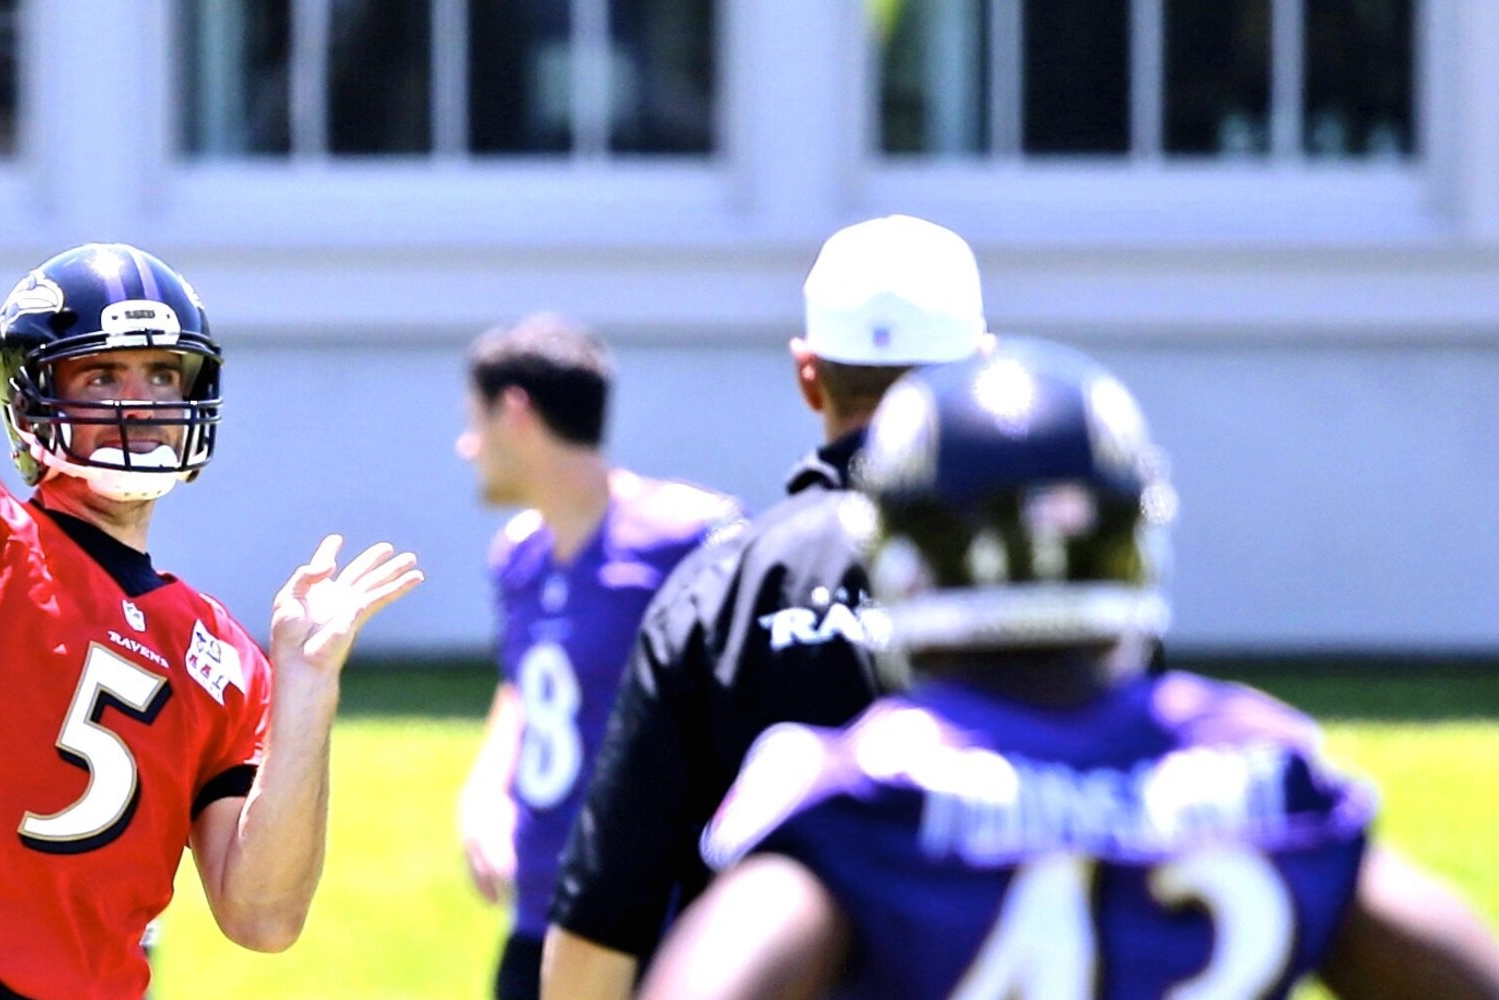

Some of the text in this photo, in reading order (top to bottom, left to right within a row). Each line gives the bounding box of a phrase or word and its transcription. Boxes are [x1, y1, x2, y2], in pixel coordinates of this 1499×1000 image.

[107, 630, 170, 669] RAVENS
[516, 642, 583, 809] 8
[17, 641, 174, 855] 5
